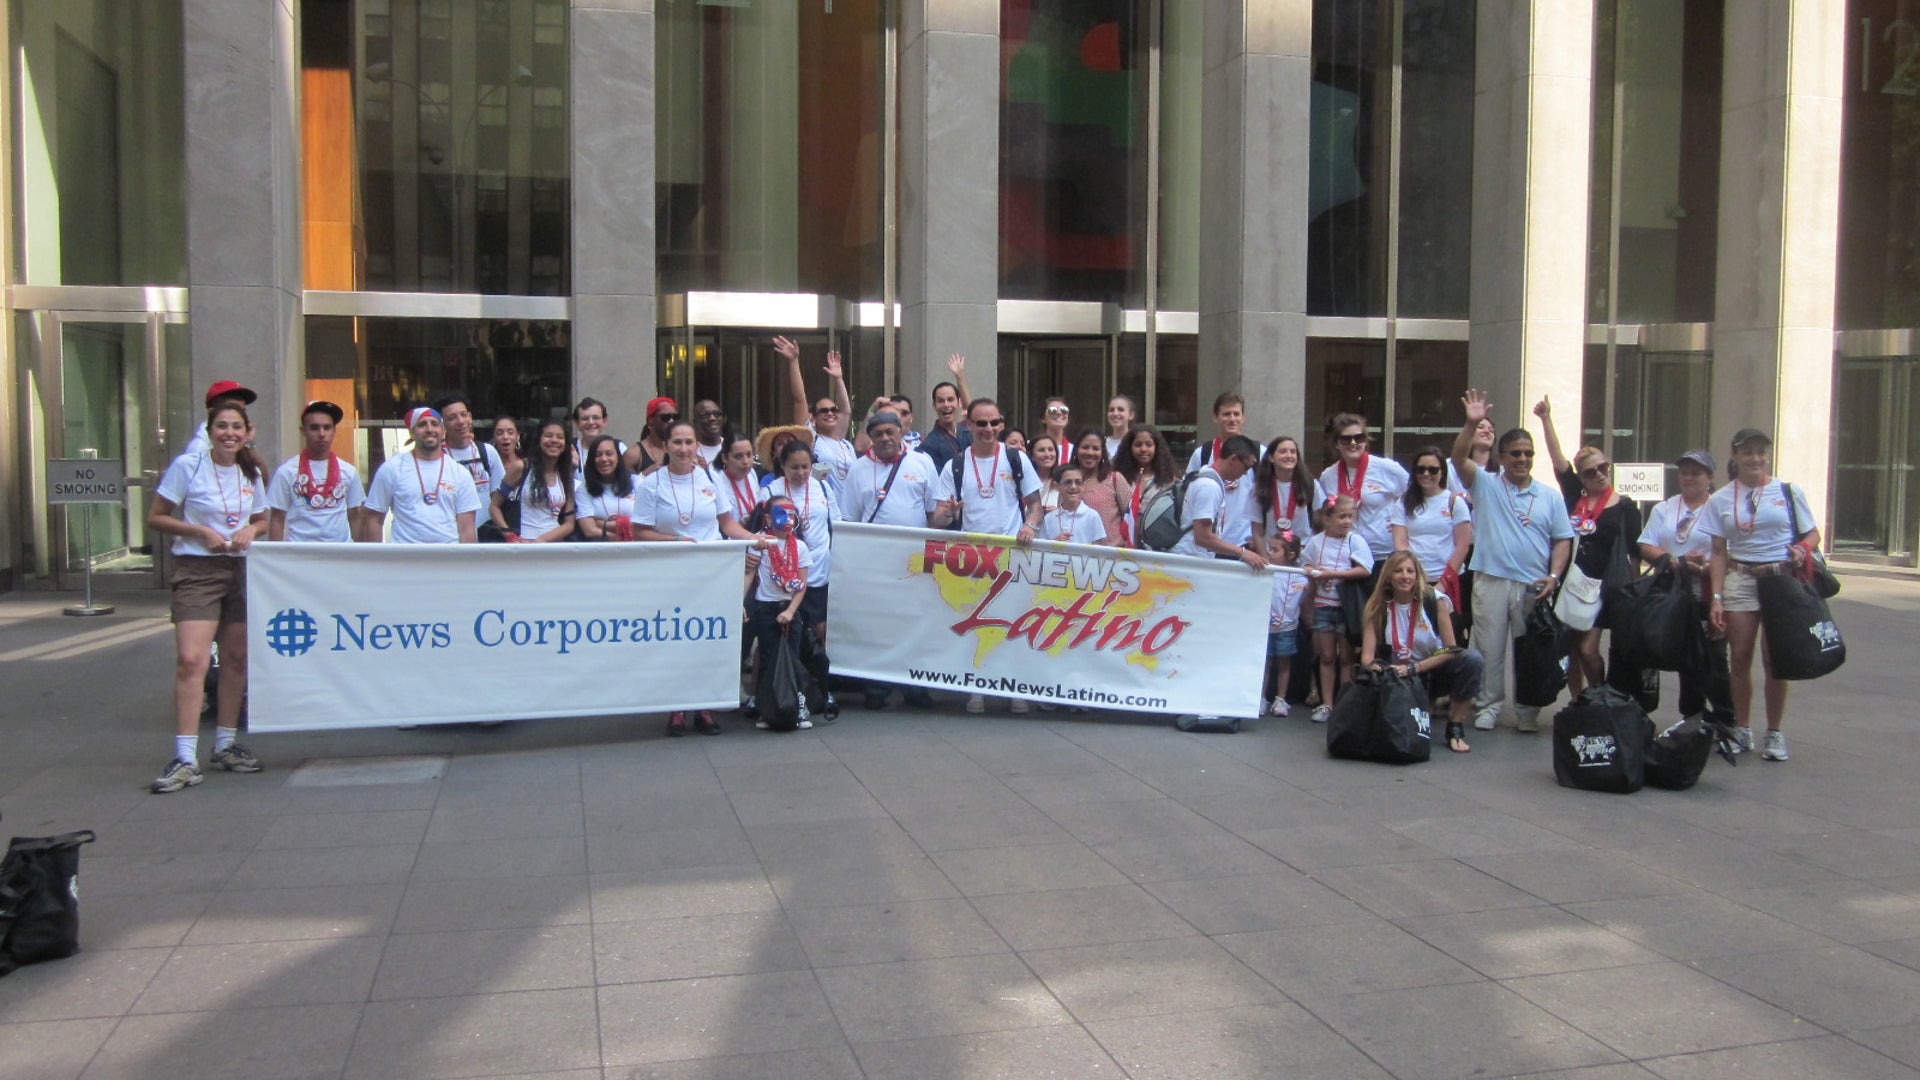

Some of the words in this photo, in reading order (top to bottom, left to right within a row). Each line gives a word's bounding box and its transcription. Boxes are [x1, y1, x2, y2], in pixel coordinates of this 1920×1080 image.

[75, 468, 96, 480] NO
[1632, 471, 1646, 481] NO
[55, 483, 117, 495] SMOKING
[1618, 483, 1660, 493] SMOKING
[923, 539, 1004, 580] FOX
[1007, 546, 1142, 596] NEWS
[951, 569, 1192, 655] Latino
[330, 613, 451, 652] News
[473, 606, 728, 654] Corporation
[908, 667, 1168, 708] www.FoxNewsLatino.com
